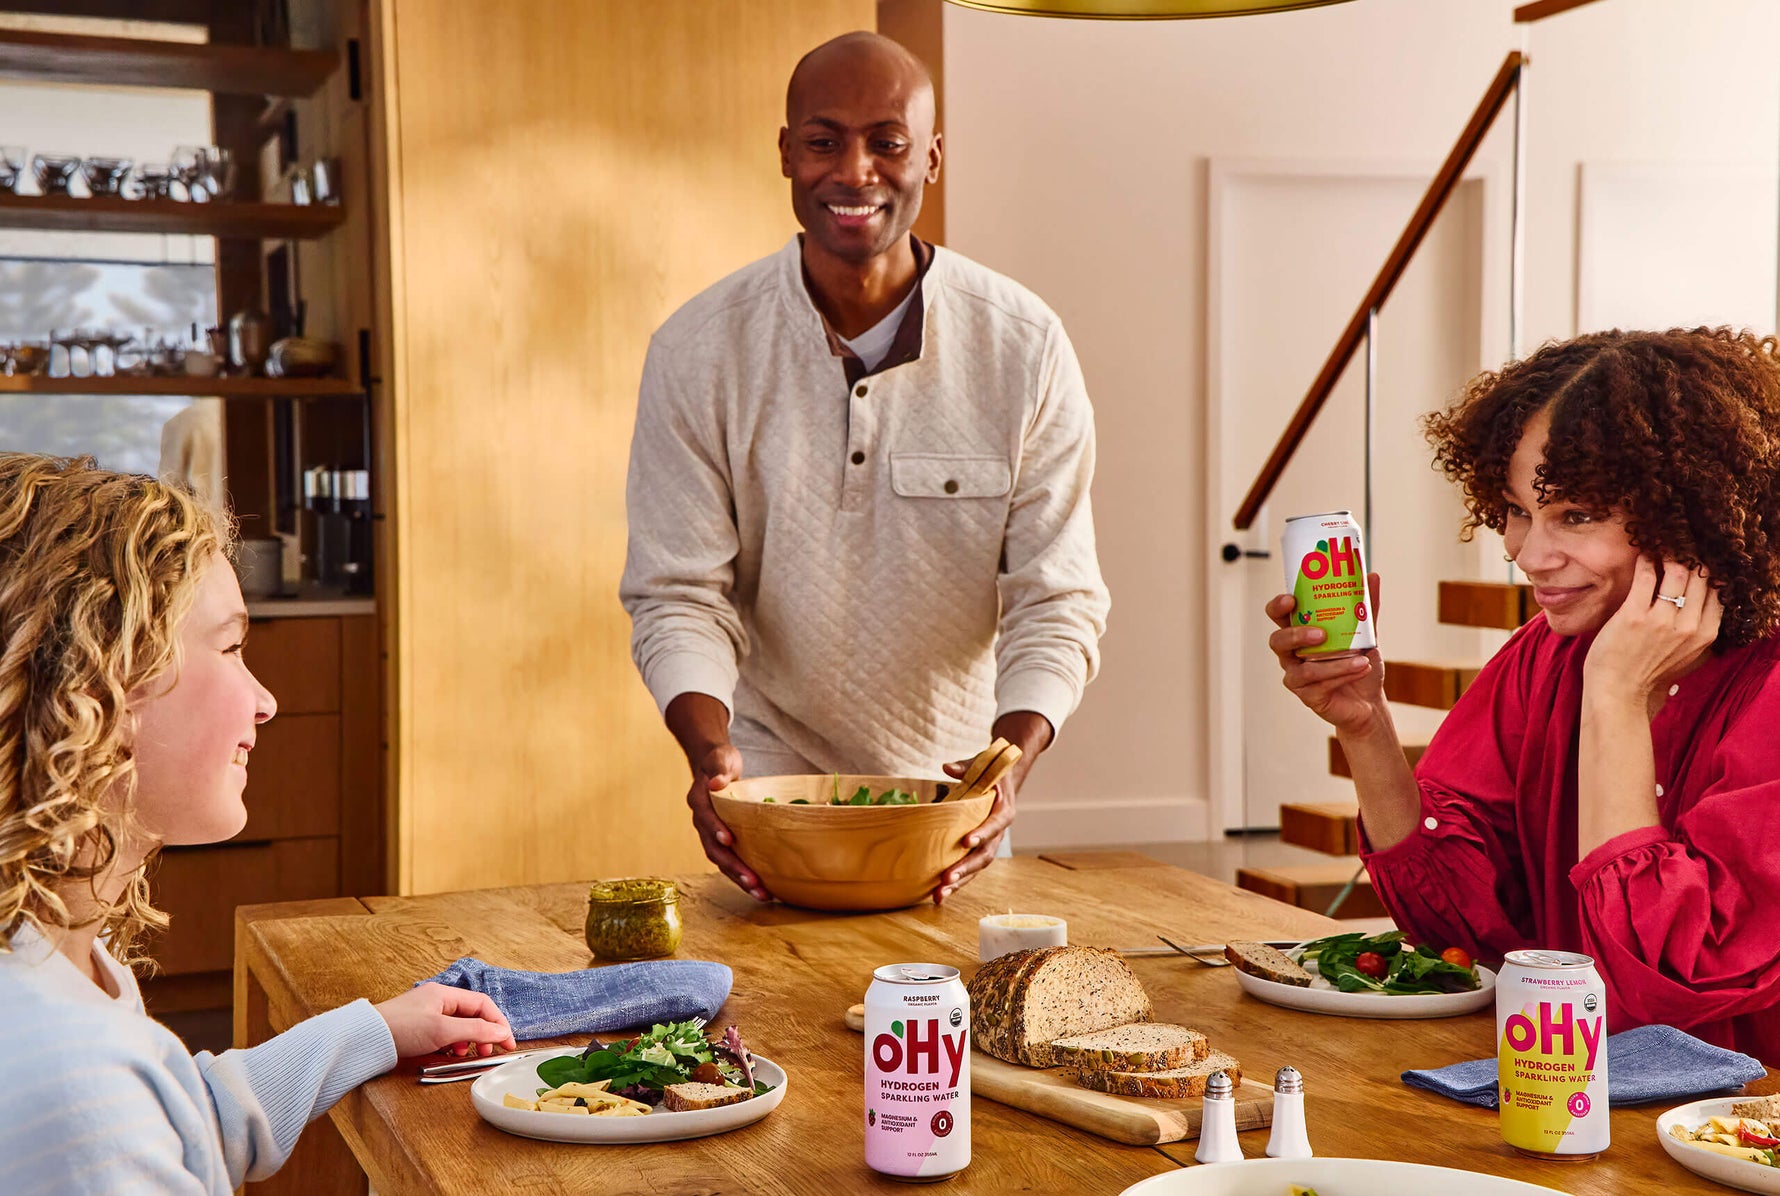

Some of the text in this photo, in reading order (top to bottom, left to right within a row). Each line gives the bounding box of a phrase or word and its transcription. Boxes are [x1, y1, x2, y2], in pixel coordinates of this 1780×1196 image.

[1312, 582, 1356, 592] HYDROGEN
[1314, 591, 1352, 600] SPARKLING
[1520, 976, 1564, 986] STRAWBERRY
[1514, 1058, 1575, 1072] HYDROGEN
[1515, 1070, 1566, 1082] SPARKLING
[881, 1080, 940, 1091] HYDROGEN
[881, 1091, 959, 1102] SPARKLING WATER
[1516, 1090, 1548, 1100] MAGNESIUM
[1516, 1096, 1552, 1106] ANTIOXIDANT
[1516, 1102, 1539, 1110] SUPPORT
[881, 1113, 912, 1122] MAGNESIUM
[881, 1120, 916, 1128] ANTIOXIDANT
